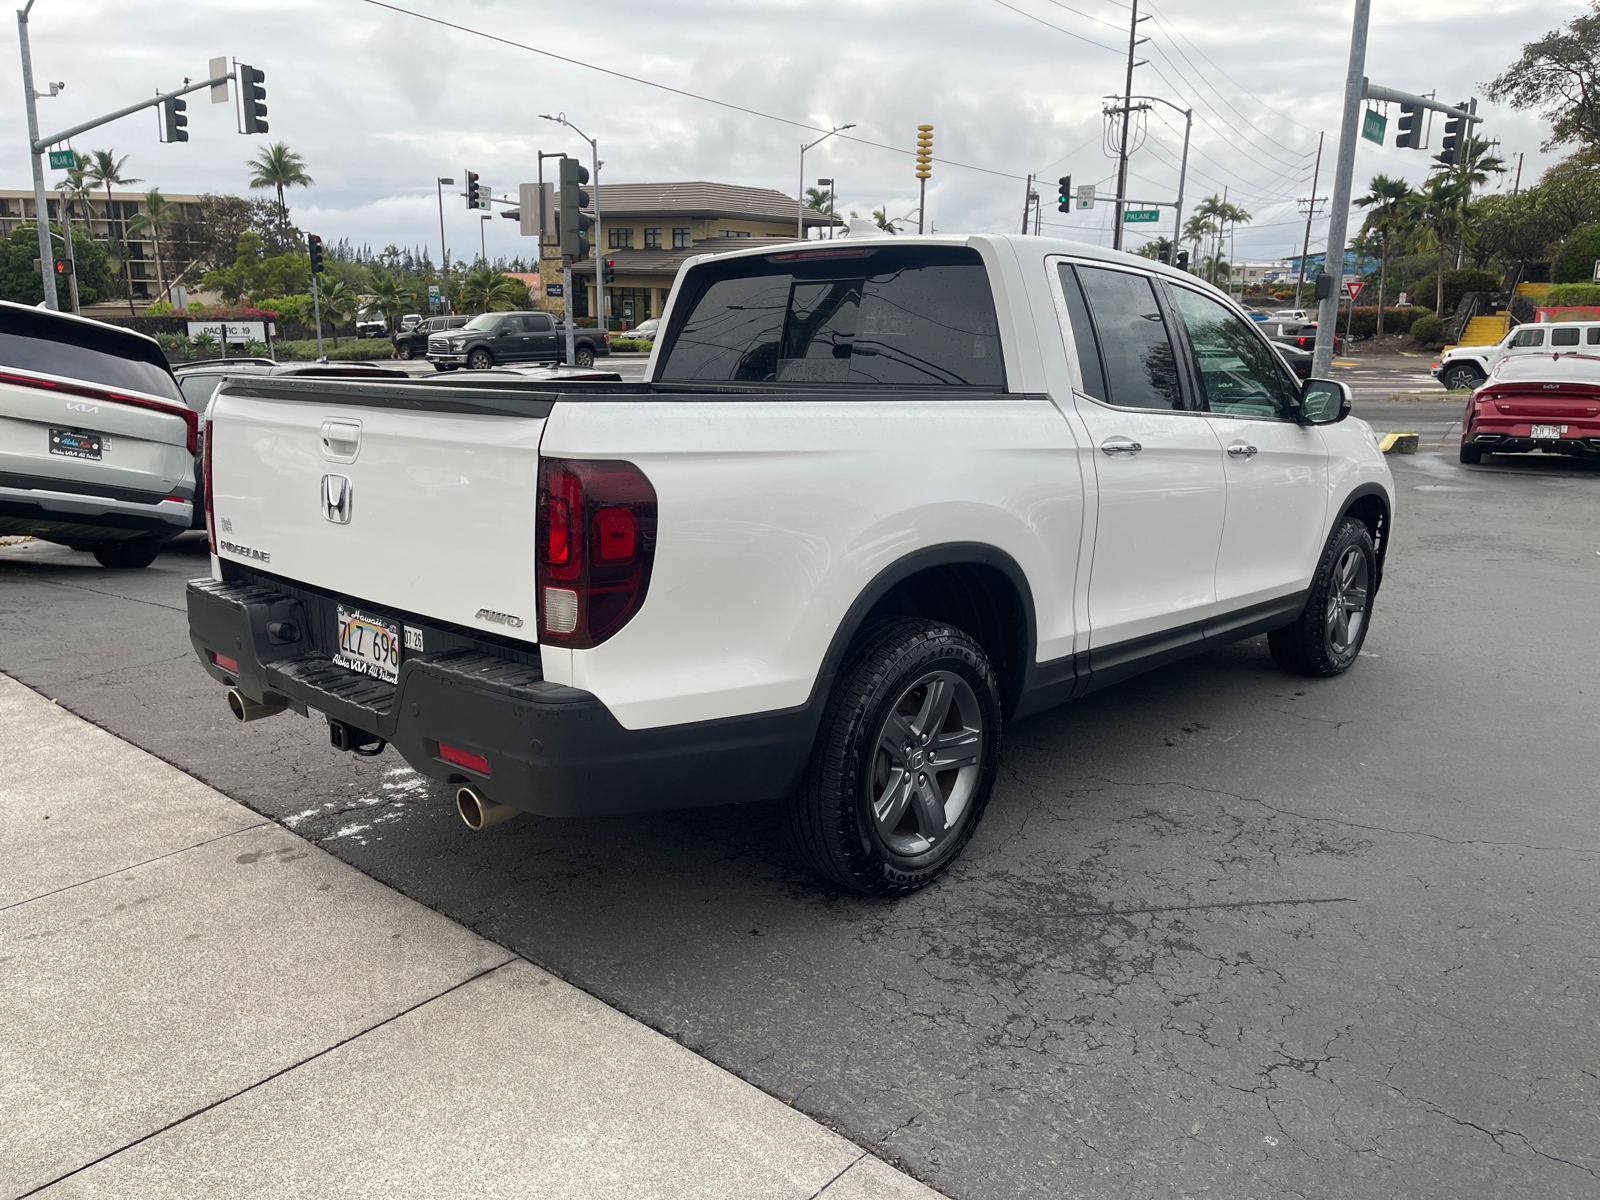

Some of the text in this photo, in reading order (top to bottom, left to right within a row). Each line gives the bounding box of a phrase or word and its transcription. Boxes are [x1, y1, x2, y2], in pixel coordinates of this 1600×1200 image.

[203, 327, 250, 335] PACFIC 19
[66, 402, 98, 414] KIA
[220, 540, 270, 563] RIDGELINE
[351, 610, 382, 627] Hawaii
[474, 608, 523, 628] AWD
[340, 620, 364, 657] ZLZ
[373, 631, 398, 667] 696
[332, 654, 350, 669] Aloha
[350, 659, 367, 674] KIA
[368, 665, 378, 678] All
